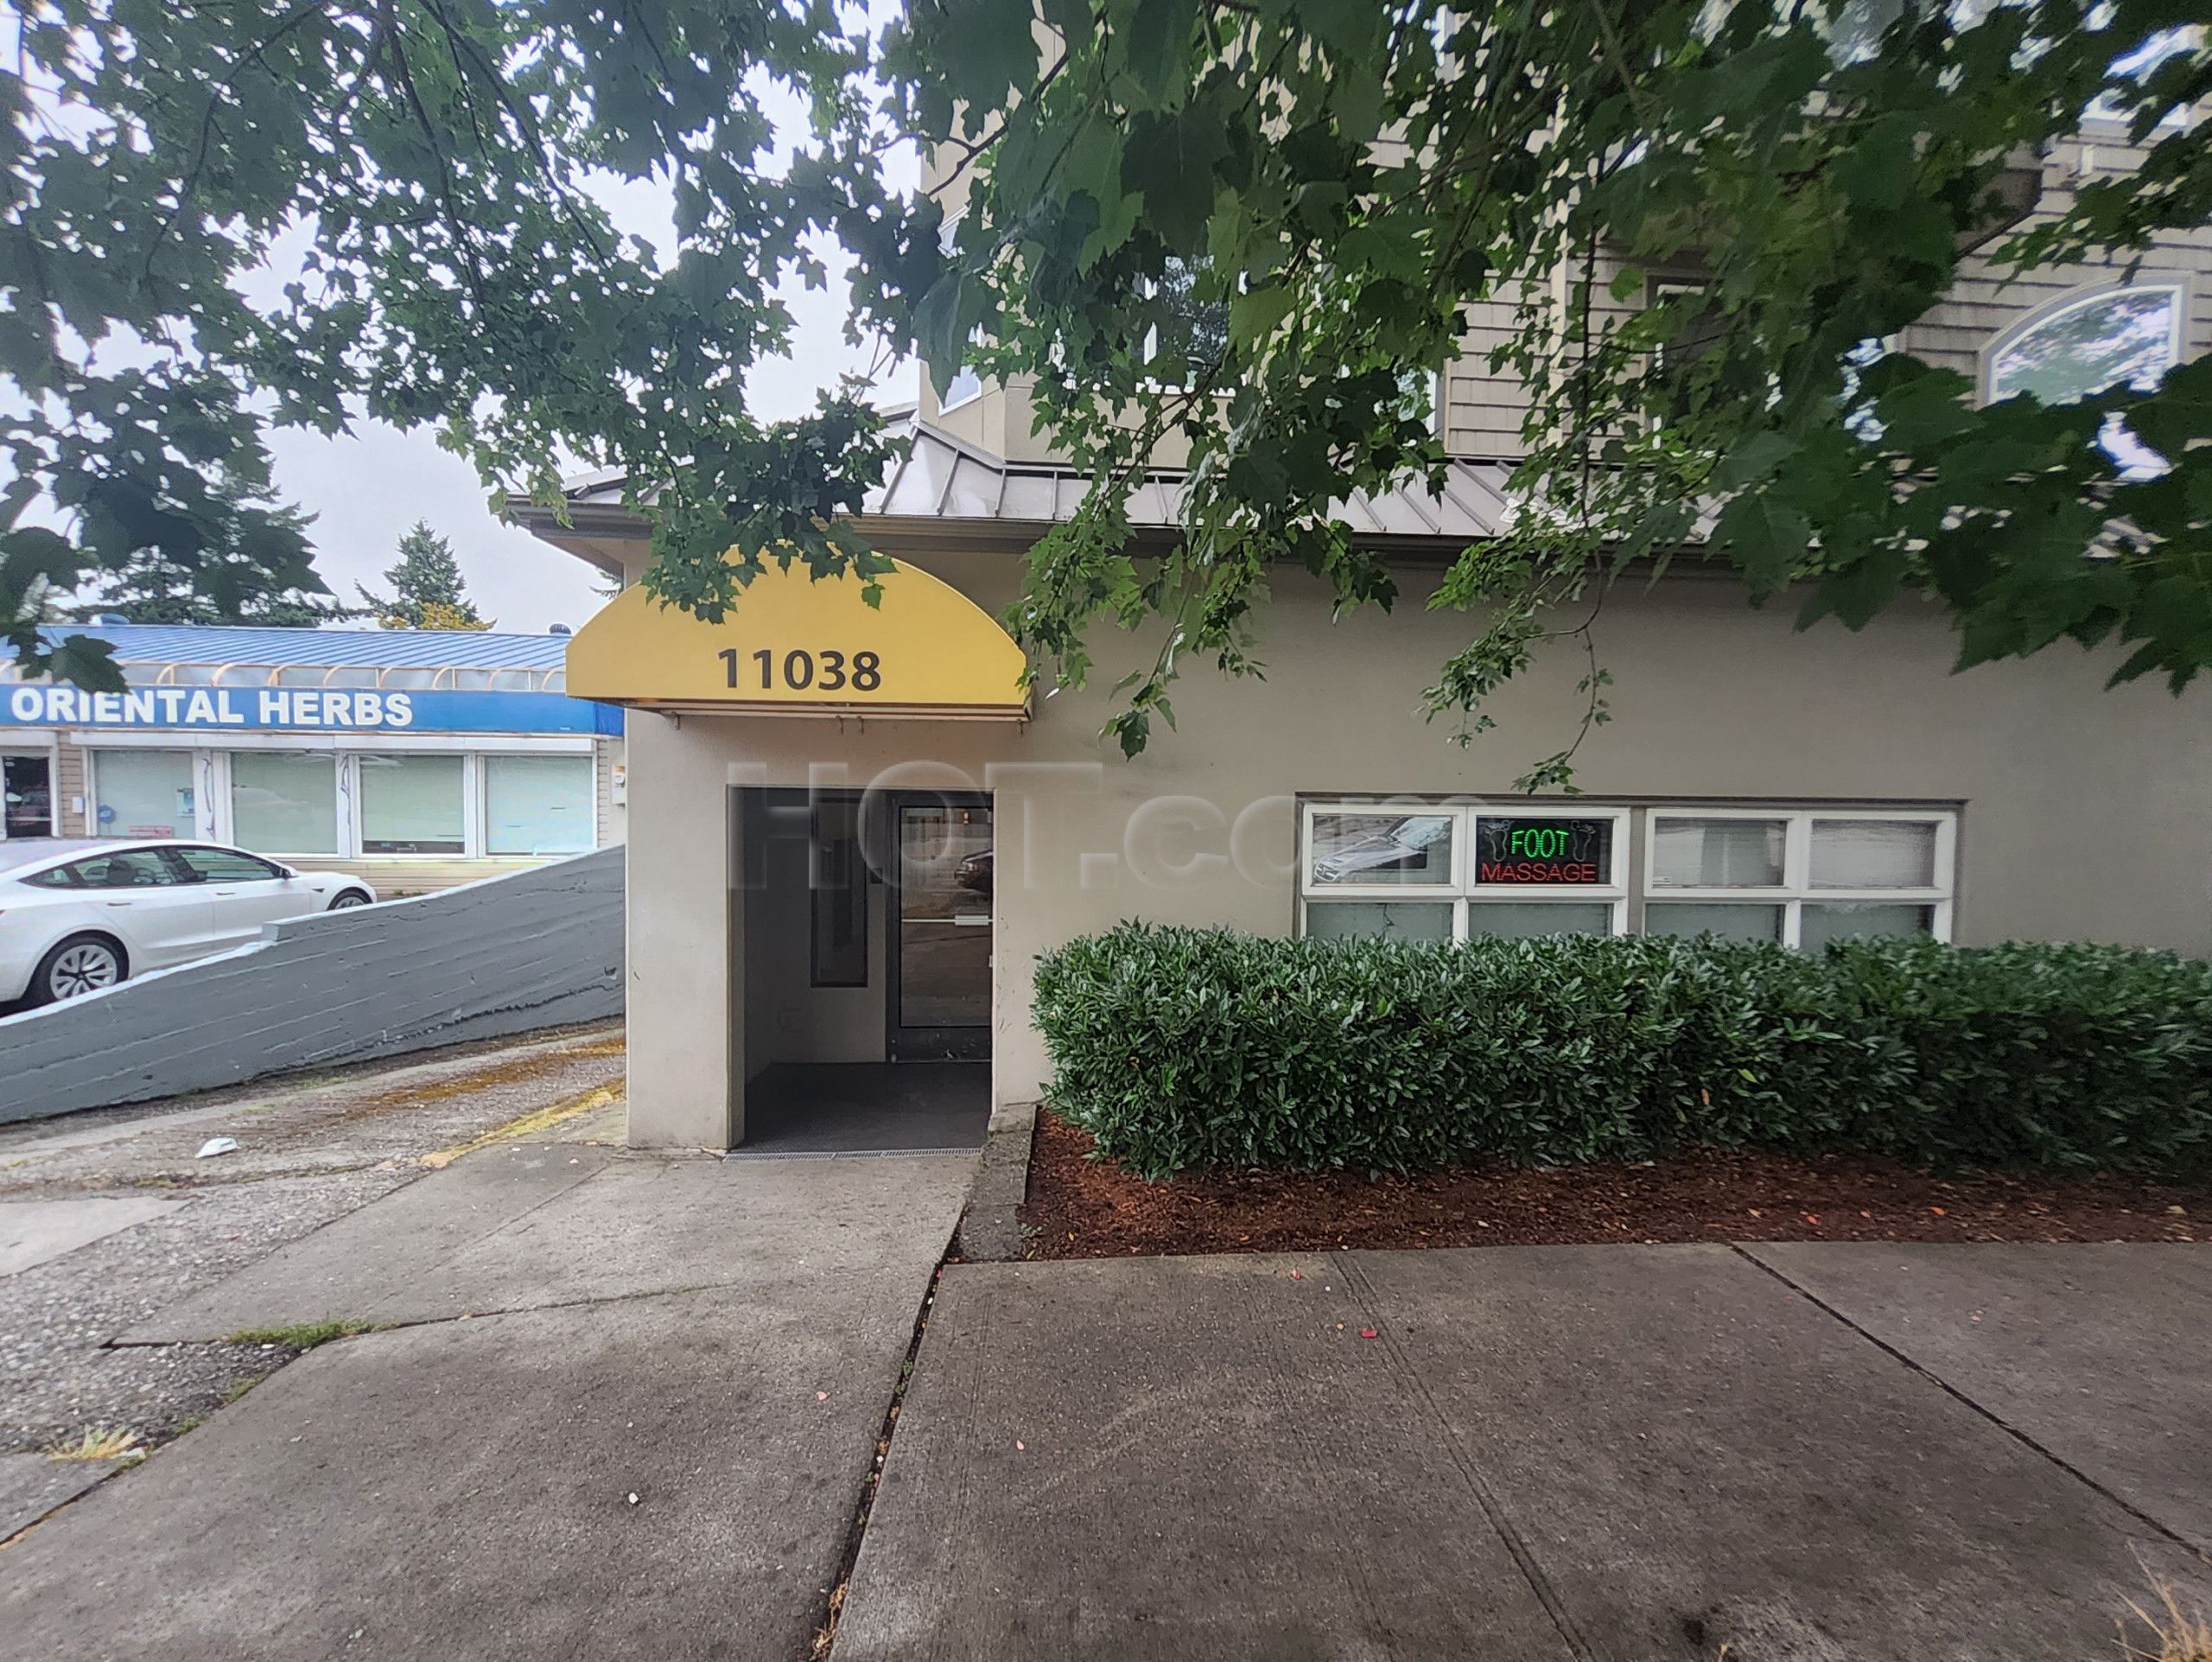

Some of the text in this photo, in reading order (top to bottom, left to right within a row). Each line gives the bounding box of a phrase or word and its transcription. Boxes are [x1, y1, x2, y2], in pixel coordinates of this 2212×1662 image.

[718, 648, 881, 691] 11038
[11, 689, 413, 727] ORIENTAL HERBS
[1511, 829, 1569, 858] FOOT
[1481, 863, 1596, 882] MASSAGE
